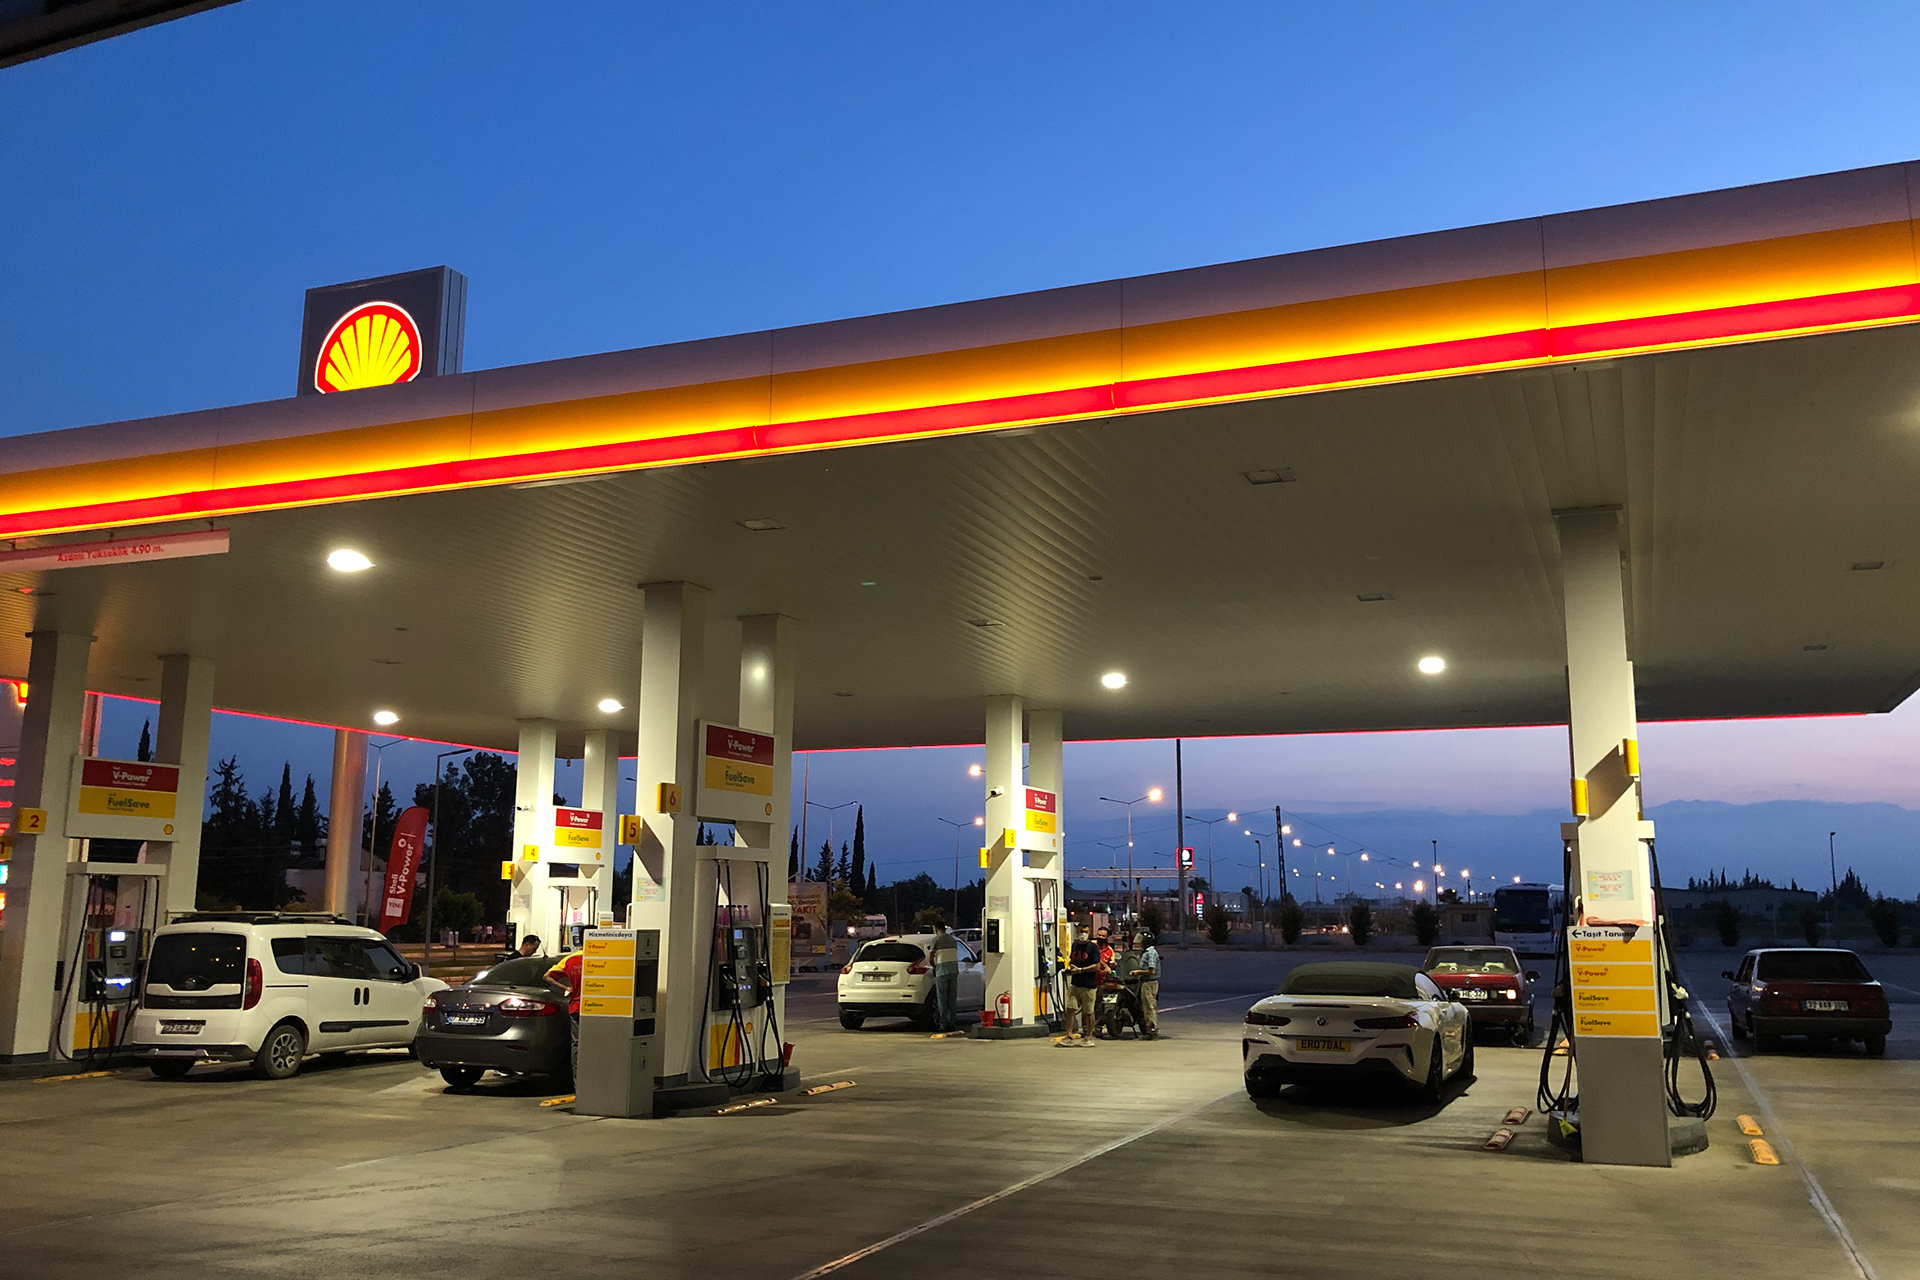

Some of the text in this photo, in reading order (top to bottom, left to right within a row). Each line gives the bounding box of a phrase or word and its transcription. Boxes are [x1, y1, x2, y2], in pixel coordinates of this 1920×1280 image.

[130, 544, 151, 555] 4.90
[112, 770, 151, 782] V-Power
[725, 770, 756, 784] FuelSave
[107, 797, 150, 809] FuelSave
[669, 790, 677, 807] 6
[29, 814, 40, 829] 2
[629, 822, 637, 838] 5
[530, 848, 536, 858] 4
[396, 843, 414, 895] V-Power
[389, 873, 399, 895] Shell
[1582, 930, 1602, 939] Taşıt
